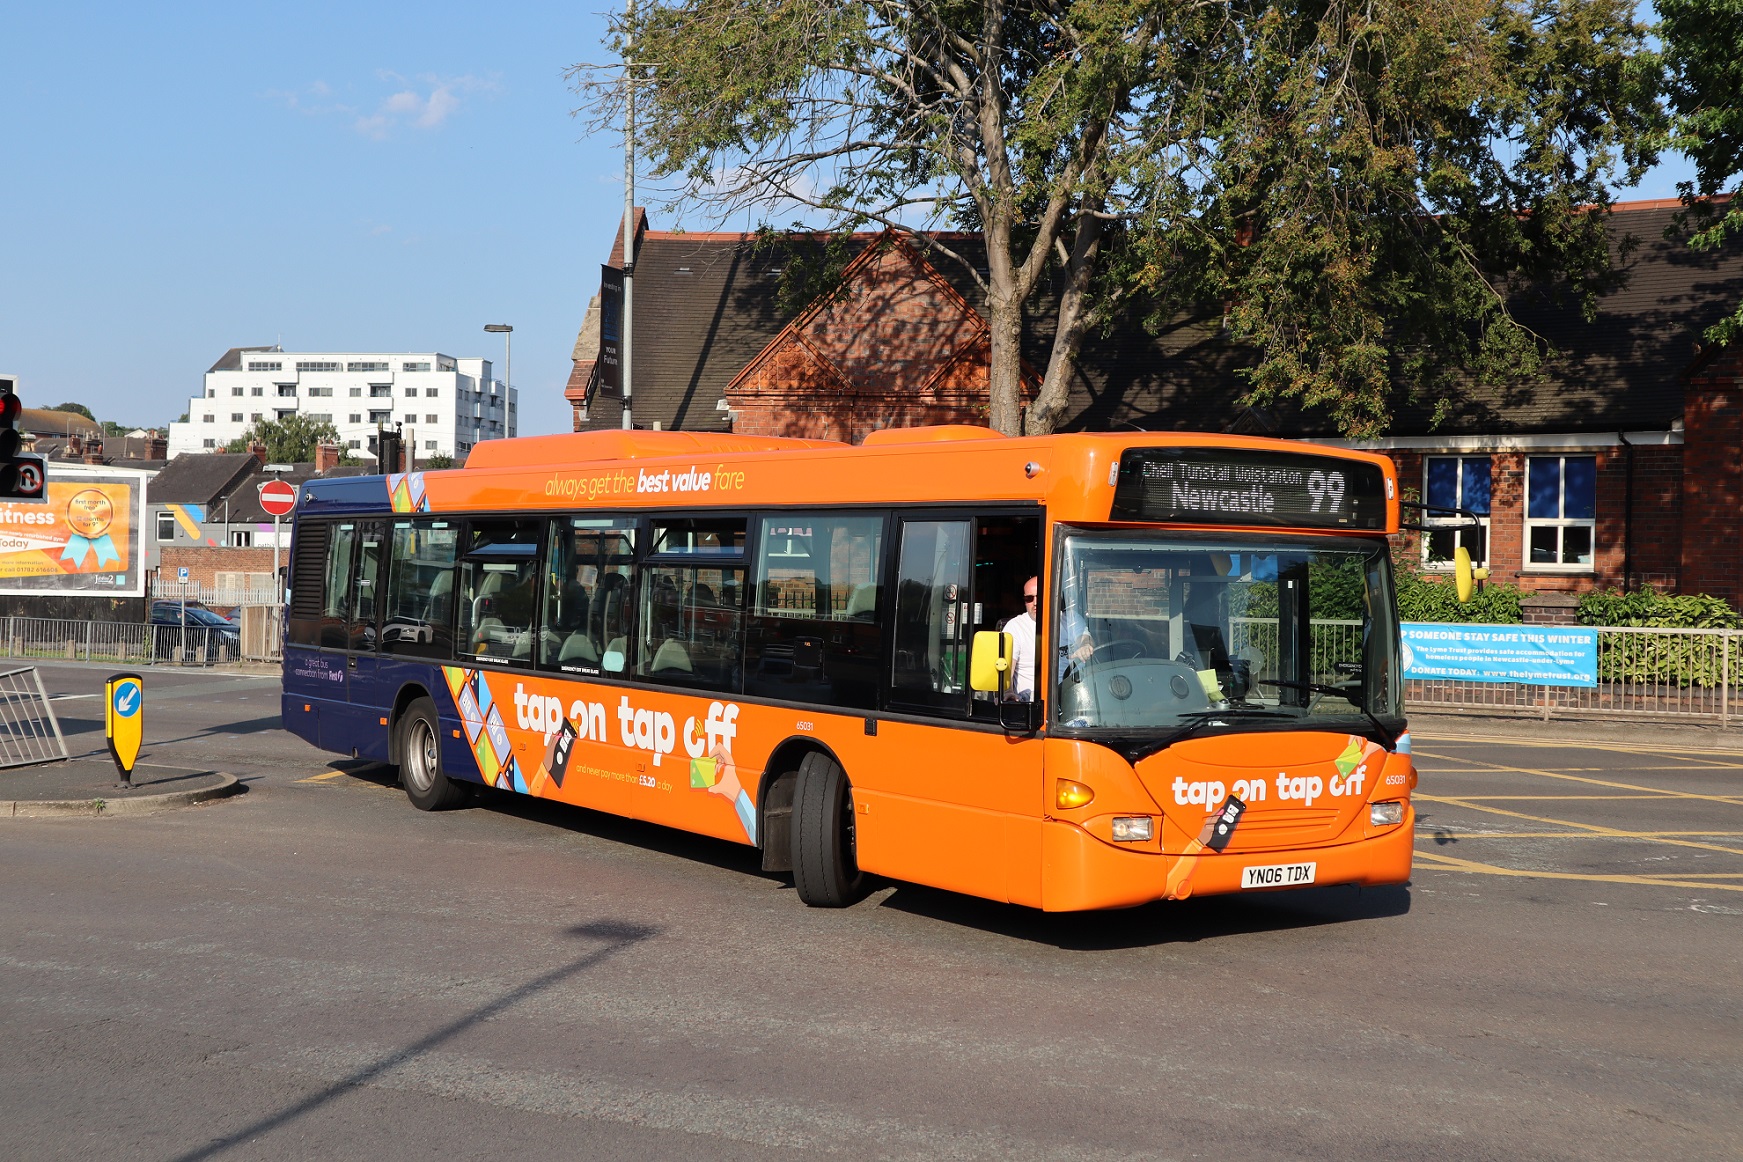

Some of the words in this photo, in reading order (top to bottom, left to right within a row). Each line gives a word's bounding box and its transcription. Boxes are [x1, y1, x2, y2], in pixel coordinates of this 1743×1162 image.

[604, 355, 618, 365] Future
[545, 473, 587, 500] always
[588, 476, 611, 500] get
[613, 470, 634, 493] the
[636, 468, 670, 493] best
[672, 466, 712, 492] value
[714, 464, 745, 490] fare
[1172, 480, 1274, 512] Newcastle
[1307, 470, 1345, 512] 99
[1409, 630, 1462, 640] SOMEONE
[1464, 632, 1490, 642] STAY
[1492, 633, 1518, 642] SAFE
[1520, 634, 1545, 643] THIS
[1547, 635, 1591, 644] WINTER
[308, 659, 320, 668] great
[320, 660, 328, 669] bus
[318, 669, 328, 680] from
[329, 670, 337, 681] First
[1448, 668, 1480, 676] TODAY:
[1483, 670, 1590, 682] www.thelymetrust.org
[514, 683, 564, 746] tap
[570, 700, 606, 742] on
[618, 696, 676, 766] tap
[683, 702, 740, 758] off
[796, 721, 814, 730] 65031
[576, 764, 586, 774] and
[587, 766, 600, 776] never
[601, 769, 611, 780] pay
[611, 772, 624, 782] more
[625, 773, 637, 784] than
[639, 774, 656, 788] £5.20
[662, 780, 673, 794] day
[1386, 774, 1406, 785] 65031
[1172, 776, 1225, 812] tap
[1232, 778, 1266, 802] on
[1276, 772, 1323, 806] tap
[1329, 764, 1367, 796] off
[1249, 868, 1282, 884] YN06
[1287, 866, 1311, 882] TDX
